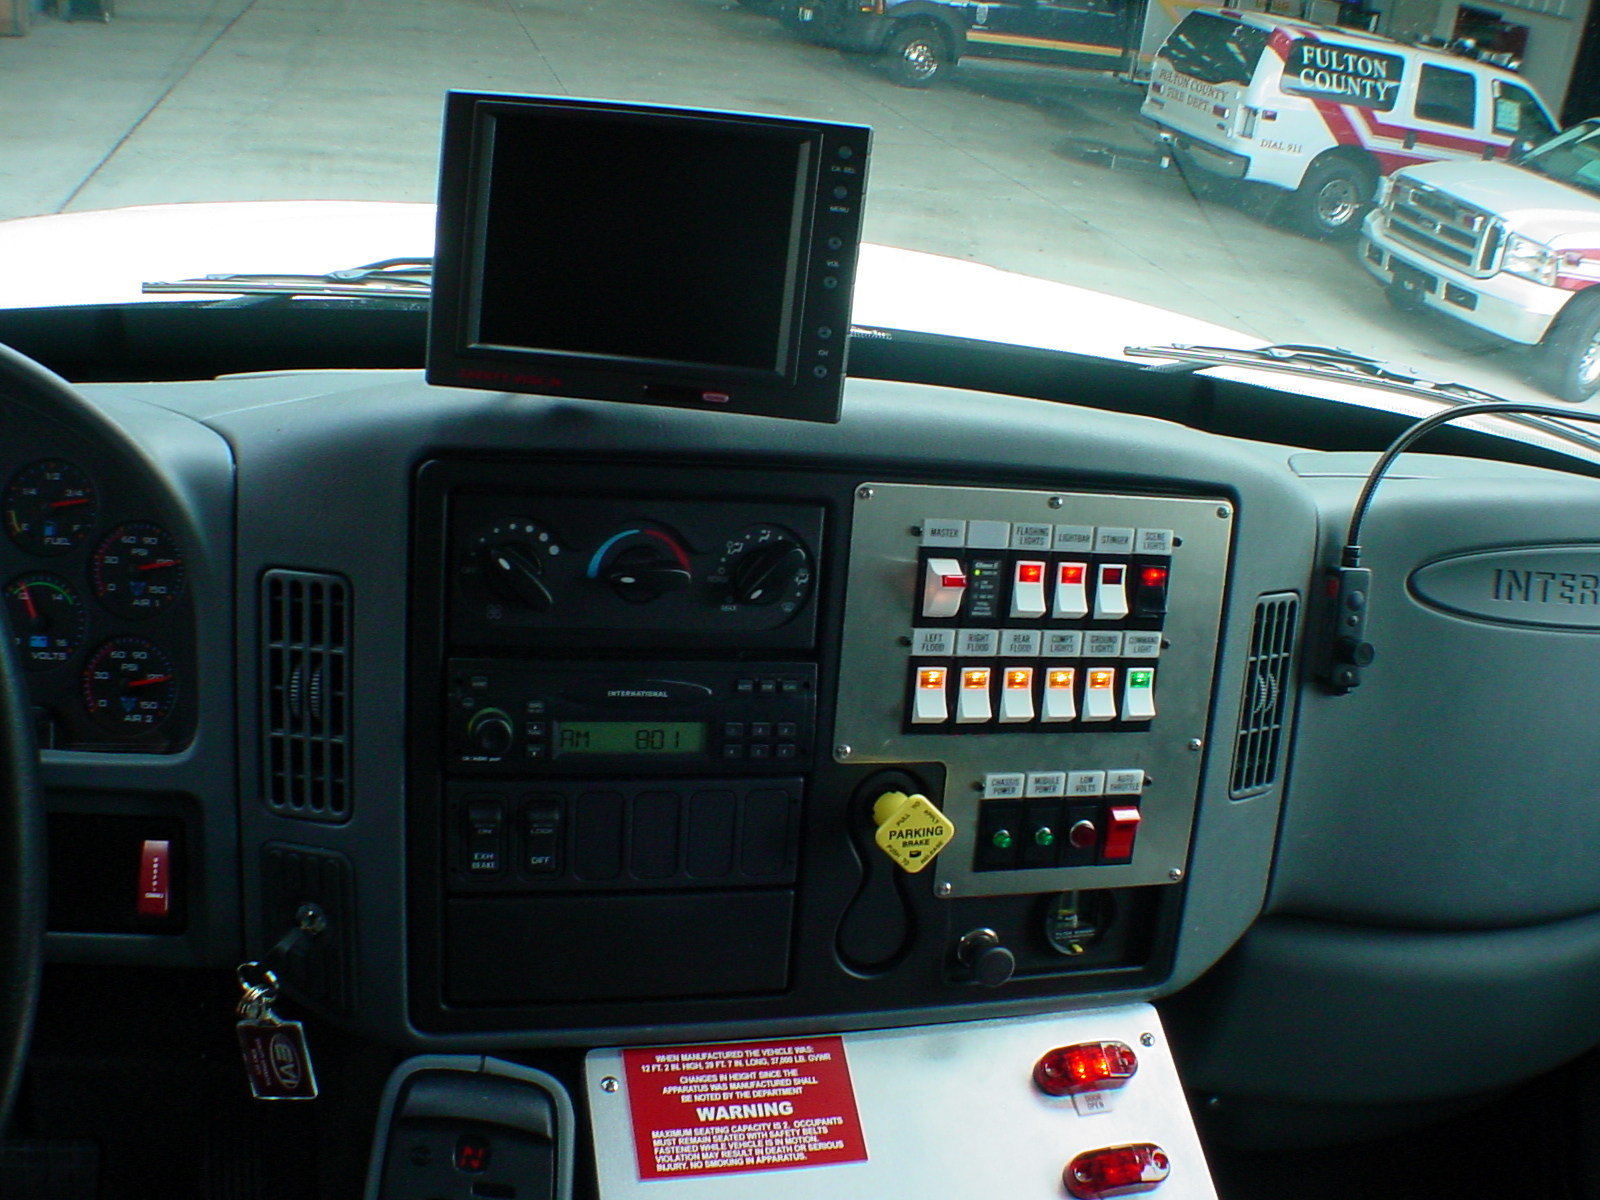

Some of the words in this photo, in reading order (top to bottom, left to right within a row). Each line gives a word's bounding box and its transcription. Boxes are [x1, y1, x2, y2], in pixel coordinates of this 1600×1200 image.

[1302, 45, 1388, 78] FULTON
[1160, 69, 1190, 88] FULTON
[1189, 80, 1228, 102] COUNTY
[1300, 68, 1390, 101] COUNTY
[1260, 139, 1284, 150] DIAL
[1287, 143, 1303, 153] 911
[930, 527, 959, 538] MASTER
[44, 537, 72, 545] FUEL
[122, 536, 136, 544] 60
[142, 536, 158, 545] 90
[1019, 537, 1044, 546] LIGHTS
[1059, 533, 1090, 543] LIGHTBAR
[1143, 541, 1166, 551] LIGHTS
[104, 556, 118, 564] 30
[148, 585, 167, 594] 150
[132, 598, 151, 606] AIR
[925, 633, 943, 642] LEFT
[968, 633, 990, 642] RIGHT
[1013, 634, 1031, 642] REAR
[922, 643, 945, 652] FLOOD
[967, 643, 990, 652] FLOOD
[1010, 643, 1032, 653] FLOOD
[31, 652, 67, 660] VOLTS
[110, 651, 126, 659] 60
[132, 651, 147, 659] 90
[607, 690, 668, 698] INTERNATIONAL
[139, 701, 158, 709] 150
[123, 714, 142, 722] AIR
[145, 714, 153, 723] 2
[560, 730, 590, 748] AM
[636, 729, 680, 750] 801
[1034, 776, 1060, 785] MODULE
[1080, 775, 1094, 784] LOW
[993, 787, 1016, 796] POWER
[1035, 786, 1057, 794] POWER
[1075, 784, 1096, 793] VOLTS
[896, 814, 911, 827] PULL
[889, 826, 944, 840] PARKING
[902, 838, 930, 848] BRAKE
[472, 862, 496, 870] BRAKE
[655, 1055, 680, 1064] WHEN
[681, 1051, 744, 1062] MANUFACTURED
[745, 1049, 760, 1058] THE
[761, 1047, 793, 1057] VEHICLE
[641, 1065, 650, 1073] 12
[664, 1064, 670, 1072] 2
[808, 1053, 831, 1062] GVWR
[679, 1074, 718, 1085] CHANGES
[719, 1073, 728, 1082] IN
[729, 1071, 757, 1081] HEIGHT
[758, 1070, 782, 1080] SINCE
[783, 1069, 799, 1077] THE
[662, 1085, 708, 1095] APPARATUS
[709, 1083, 728, 1092] WAS
[729, 1078, 792, 1091] MANUFACTURED
[793, 1077, 818, 1085] SHALL
[681, 1095, 693, 1104] BE
[694, 1093, 721, 1102] NOTED
[722, 1091, 734, 1100] BY
[735, 1090, 751, 1099] THE
[752, 1087, 803, 1098] DEPARTMENT
[1087, 1100, 1105, 1111] OPEN
[696, 1101, 793, 1122] WARNING
[651, 1127, 692, 1139] MAXIMUM
[693, 1125, 729, 1136] SEATING
[730, 1122, 771, 1134] CAPACITY
[772, 1121, 781, 1131] IS
[793, 1116, 844, 1129] OCCUPANTS
[653, 1137, 677, 1148] MUST
[678, 1135, 711, 1146] REMAIN
[712, 1132, 745, 1143] SEATED
[746, 1130, 768, 1141] WITH
[769, 1128, 800, 1139] SAFETY
[801, 1125, 829, 1136] BELTS
[654, 1144, 698, 1155] FASTENED
[699, 1142, 727, 1153] WHILE
[728, 1138, 763, 1150] VEHICLE
[764, 1138, 774, 1148] IS
[775, 1137, 783, 1146] IN
[655, 1152, 700, 1164] VIOLATION
[701, 1150, 719, 1160] MAY
[720, 1147, 753, 1159] RESULT
[754, 1147, 763, 1156] IN
[764, 1144, 793, 1155] DEATH
[794, 1143, 807, 1153] OR
[807, 1140, 845, 1152] SERIOUS
[689, 1160, 703, 1170] NO
[704, 1157, 744, 1169] SMOKING
[745, 1156, 755, 1165] IN
